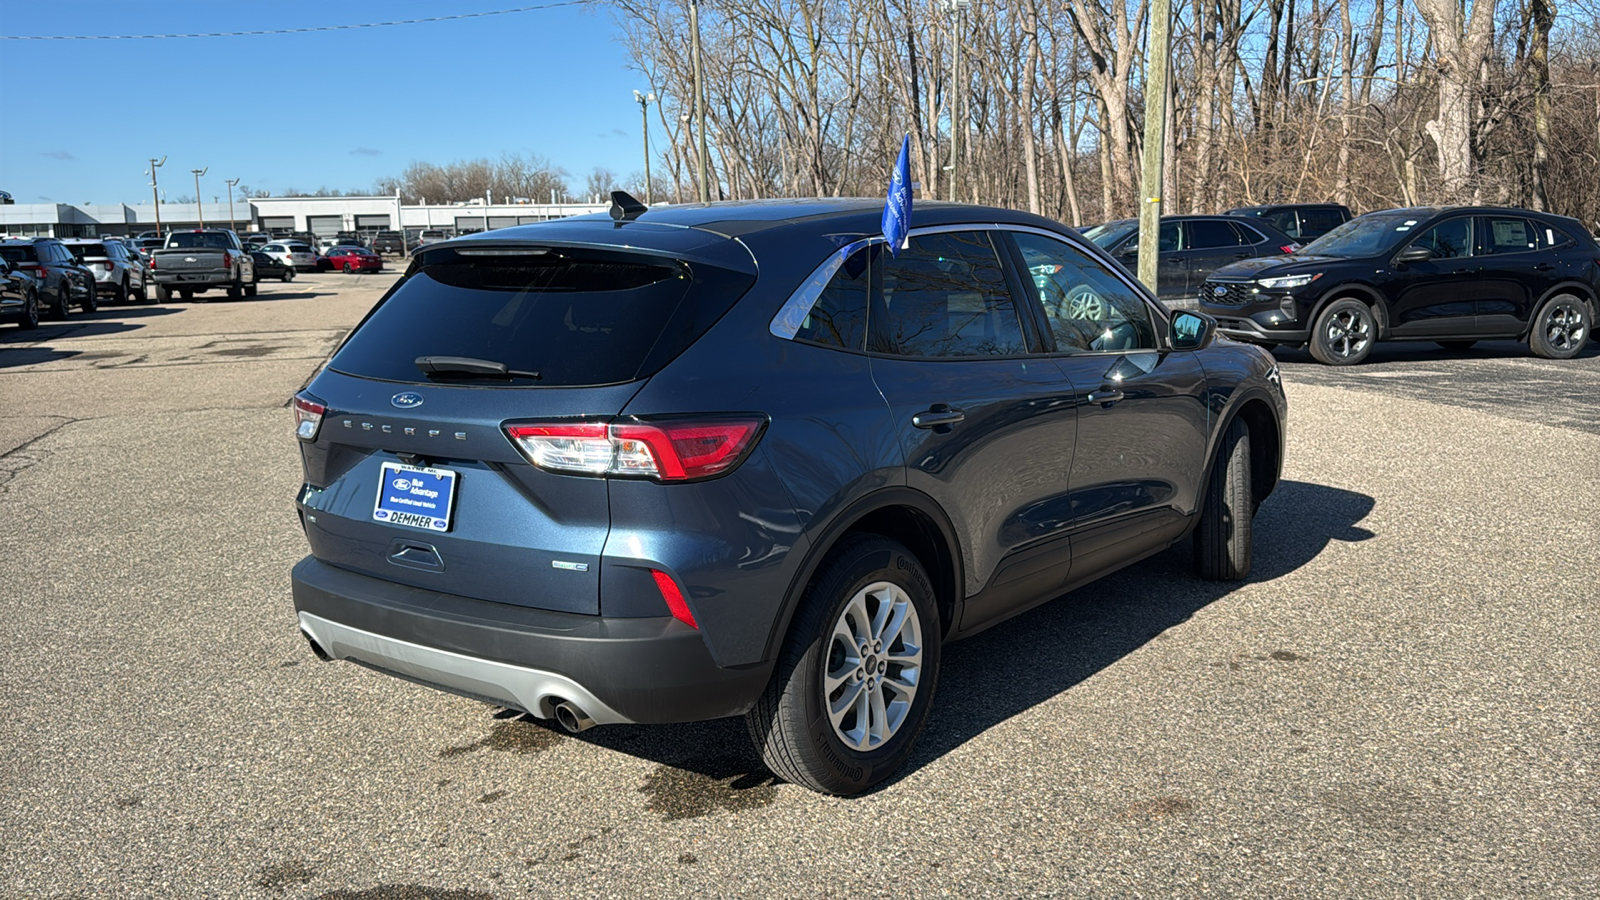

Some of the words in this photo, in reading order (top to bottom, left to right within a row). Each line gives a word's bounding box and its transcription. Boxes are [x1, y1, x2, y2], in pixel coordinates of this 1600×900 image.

[343, 420, 467, 440] ESCAPE
[411, 478, 424, 488] Blue
[410, 487, 439, 499] Advantage
[390, 511, 432, 528] DEMMER
[896, 555, 933, 600] Continental
[820, 741, 864, 782] Continental
